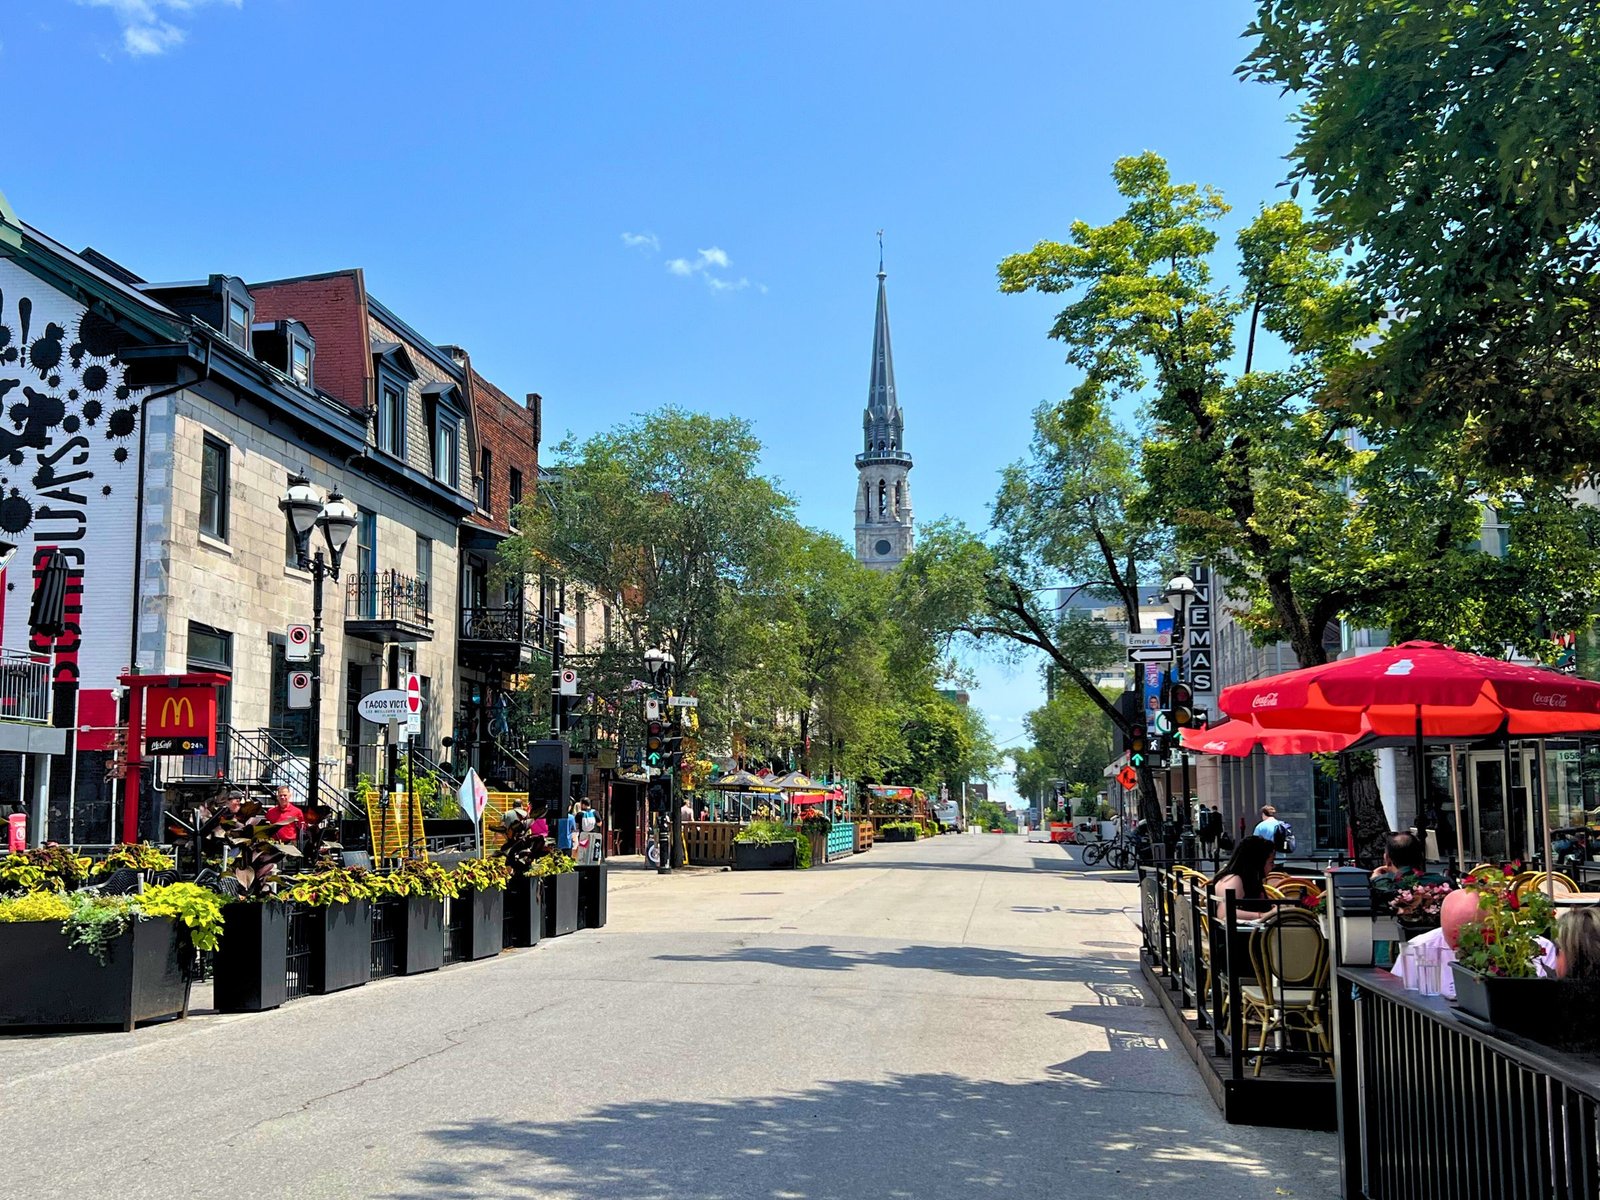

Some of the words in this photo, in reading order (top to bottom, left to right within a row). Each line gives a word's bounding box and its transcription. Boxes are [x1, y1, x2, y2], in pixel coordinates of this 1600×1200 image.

[364, 700, 388, 709] TACOS
[1252, 692, 1278, 708] Coca-Cola
[1533, 692, 1567, 708] Coca-Cola
[1559, 751, 1581, 761] 1658
